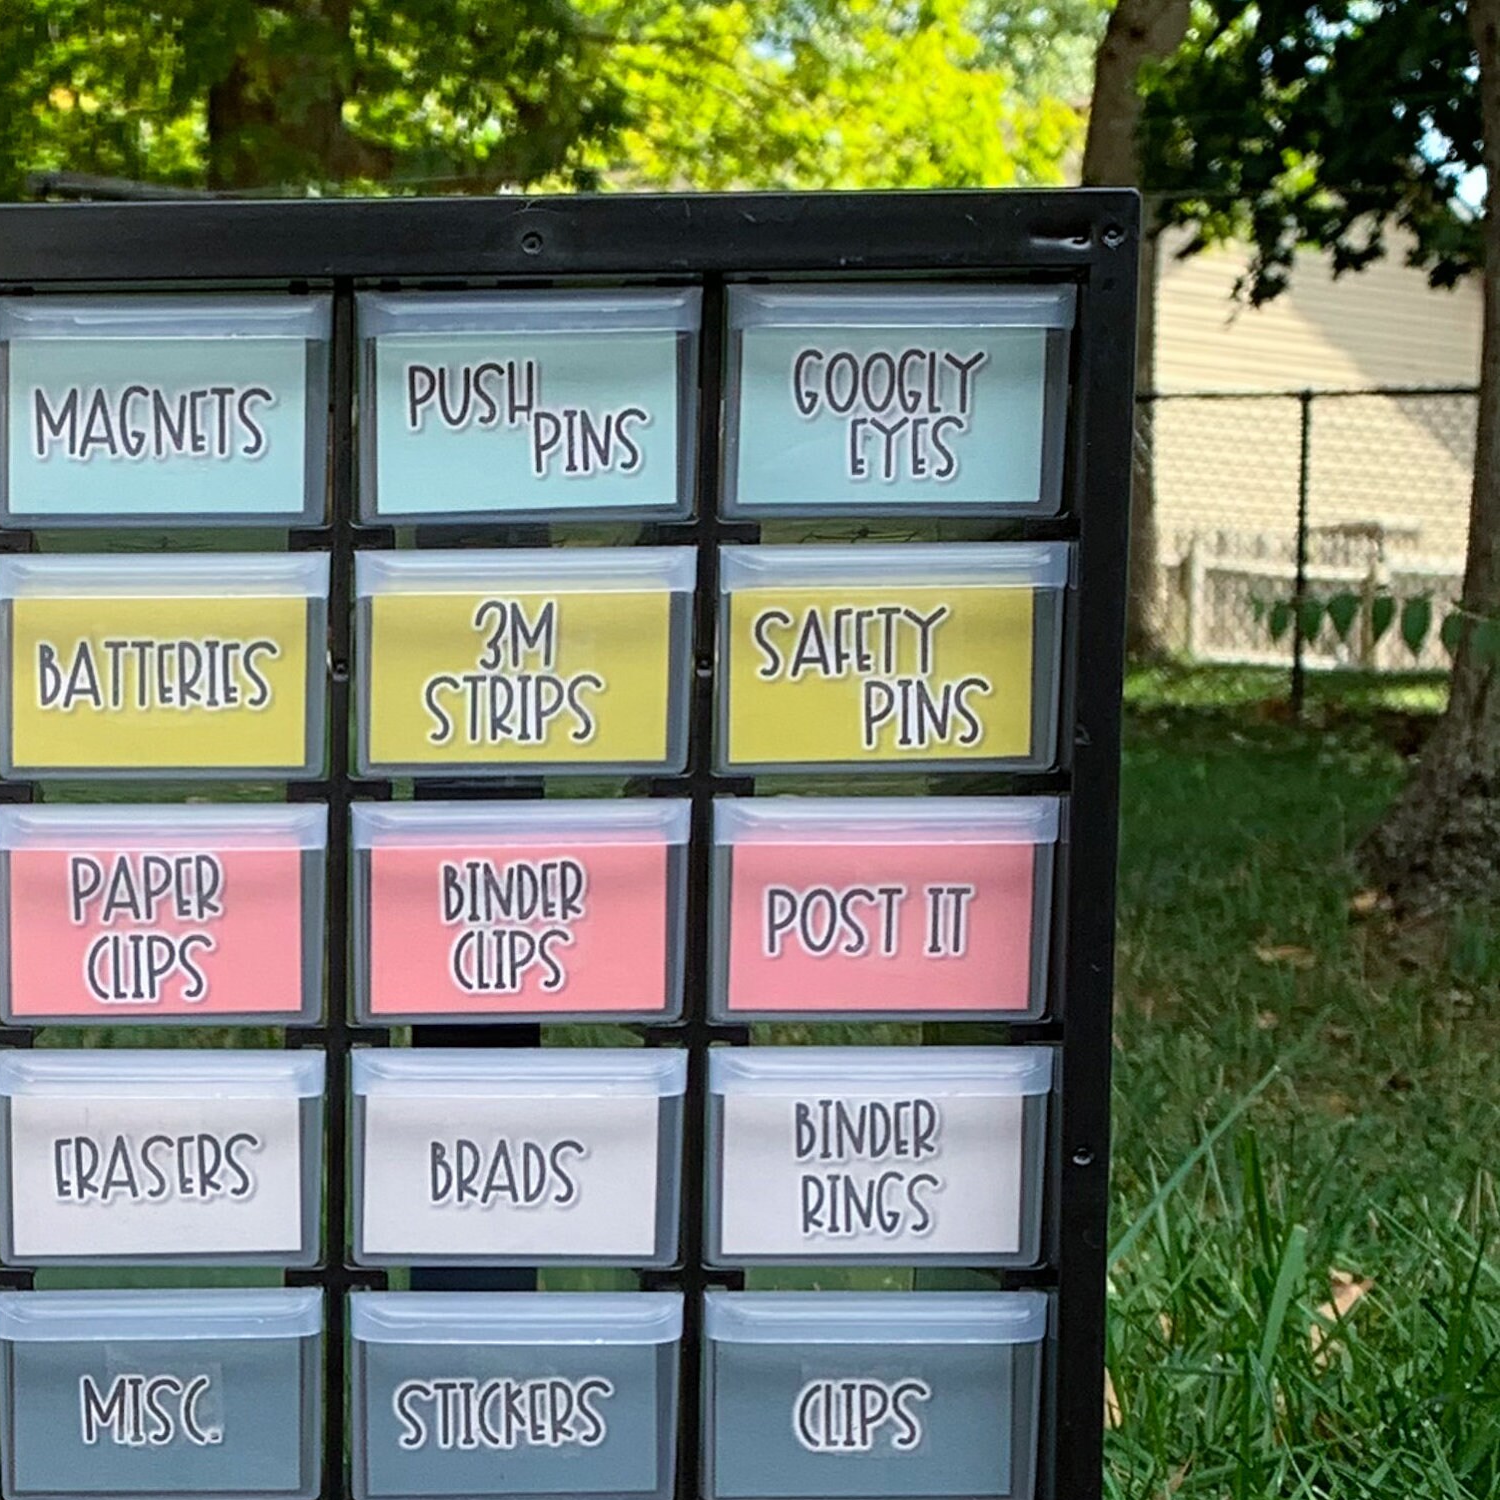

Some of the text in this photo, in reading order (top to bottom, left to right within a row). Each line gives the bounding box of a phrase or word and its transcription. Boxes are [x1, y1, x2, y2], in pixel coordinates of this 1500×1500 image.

[408, 361, 534, 426] PUSH
[794, 349, 985, 415] GOOGLY
[33, 385, 272, 458] MAGNETS
[533, 409, 648, 472] PINS
[850, 416, 964, 478] EYES
[474, 601, 554, 669] 3M
[754, 607, 946, 678] SAFETY
[38, 641, 279, 708] BATTERIES
[425, 675, 602, 741] STRIPS
[864, 678, 990, 746] PINS
[71, 855, 221, 922] PAPER
[442, 860, 584, 924] BINDER
[766, 888, 971, 954] POST IT
[87, 933, 214, 1002] CLIPS
[454, 929, 570, 991] CLIPS
[795, 1099, 937, 1158] BINDER
[54, 1134, 259, 1198] ERASERS
[430, 1140, 585, 1204] BRADS
[801, 1172, 939, 1234] RINGS
[81, 1378, 221, 1444] MISC.
[397, 1381, 611, 1446] STICKERS
[798, 1382, 929, 1448] CLIPS
